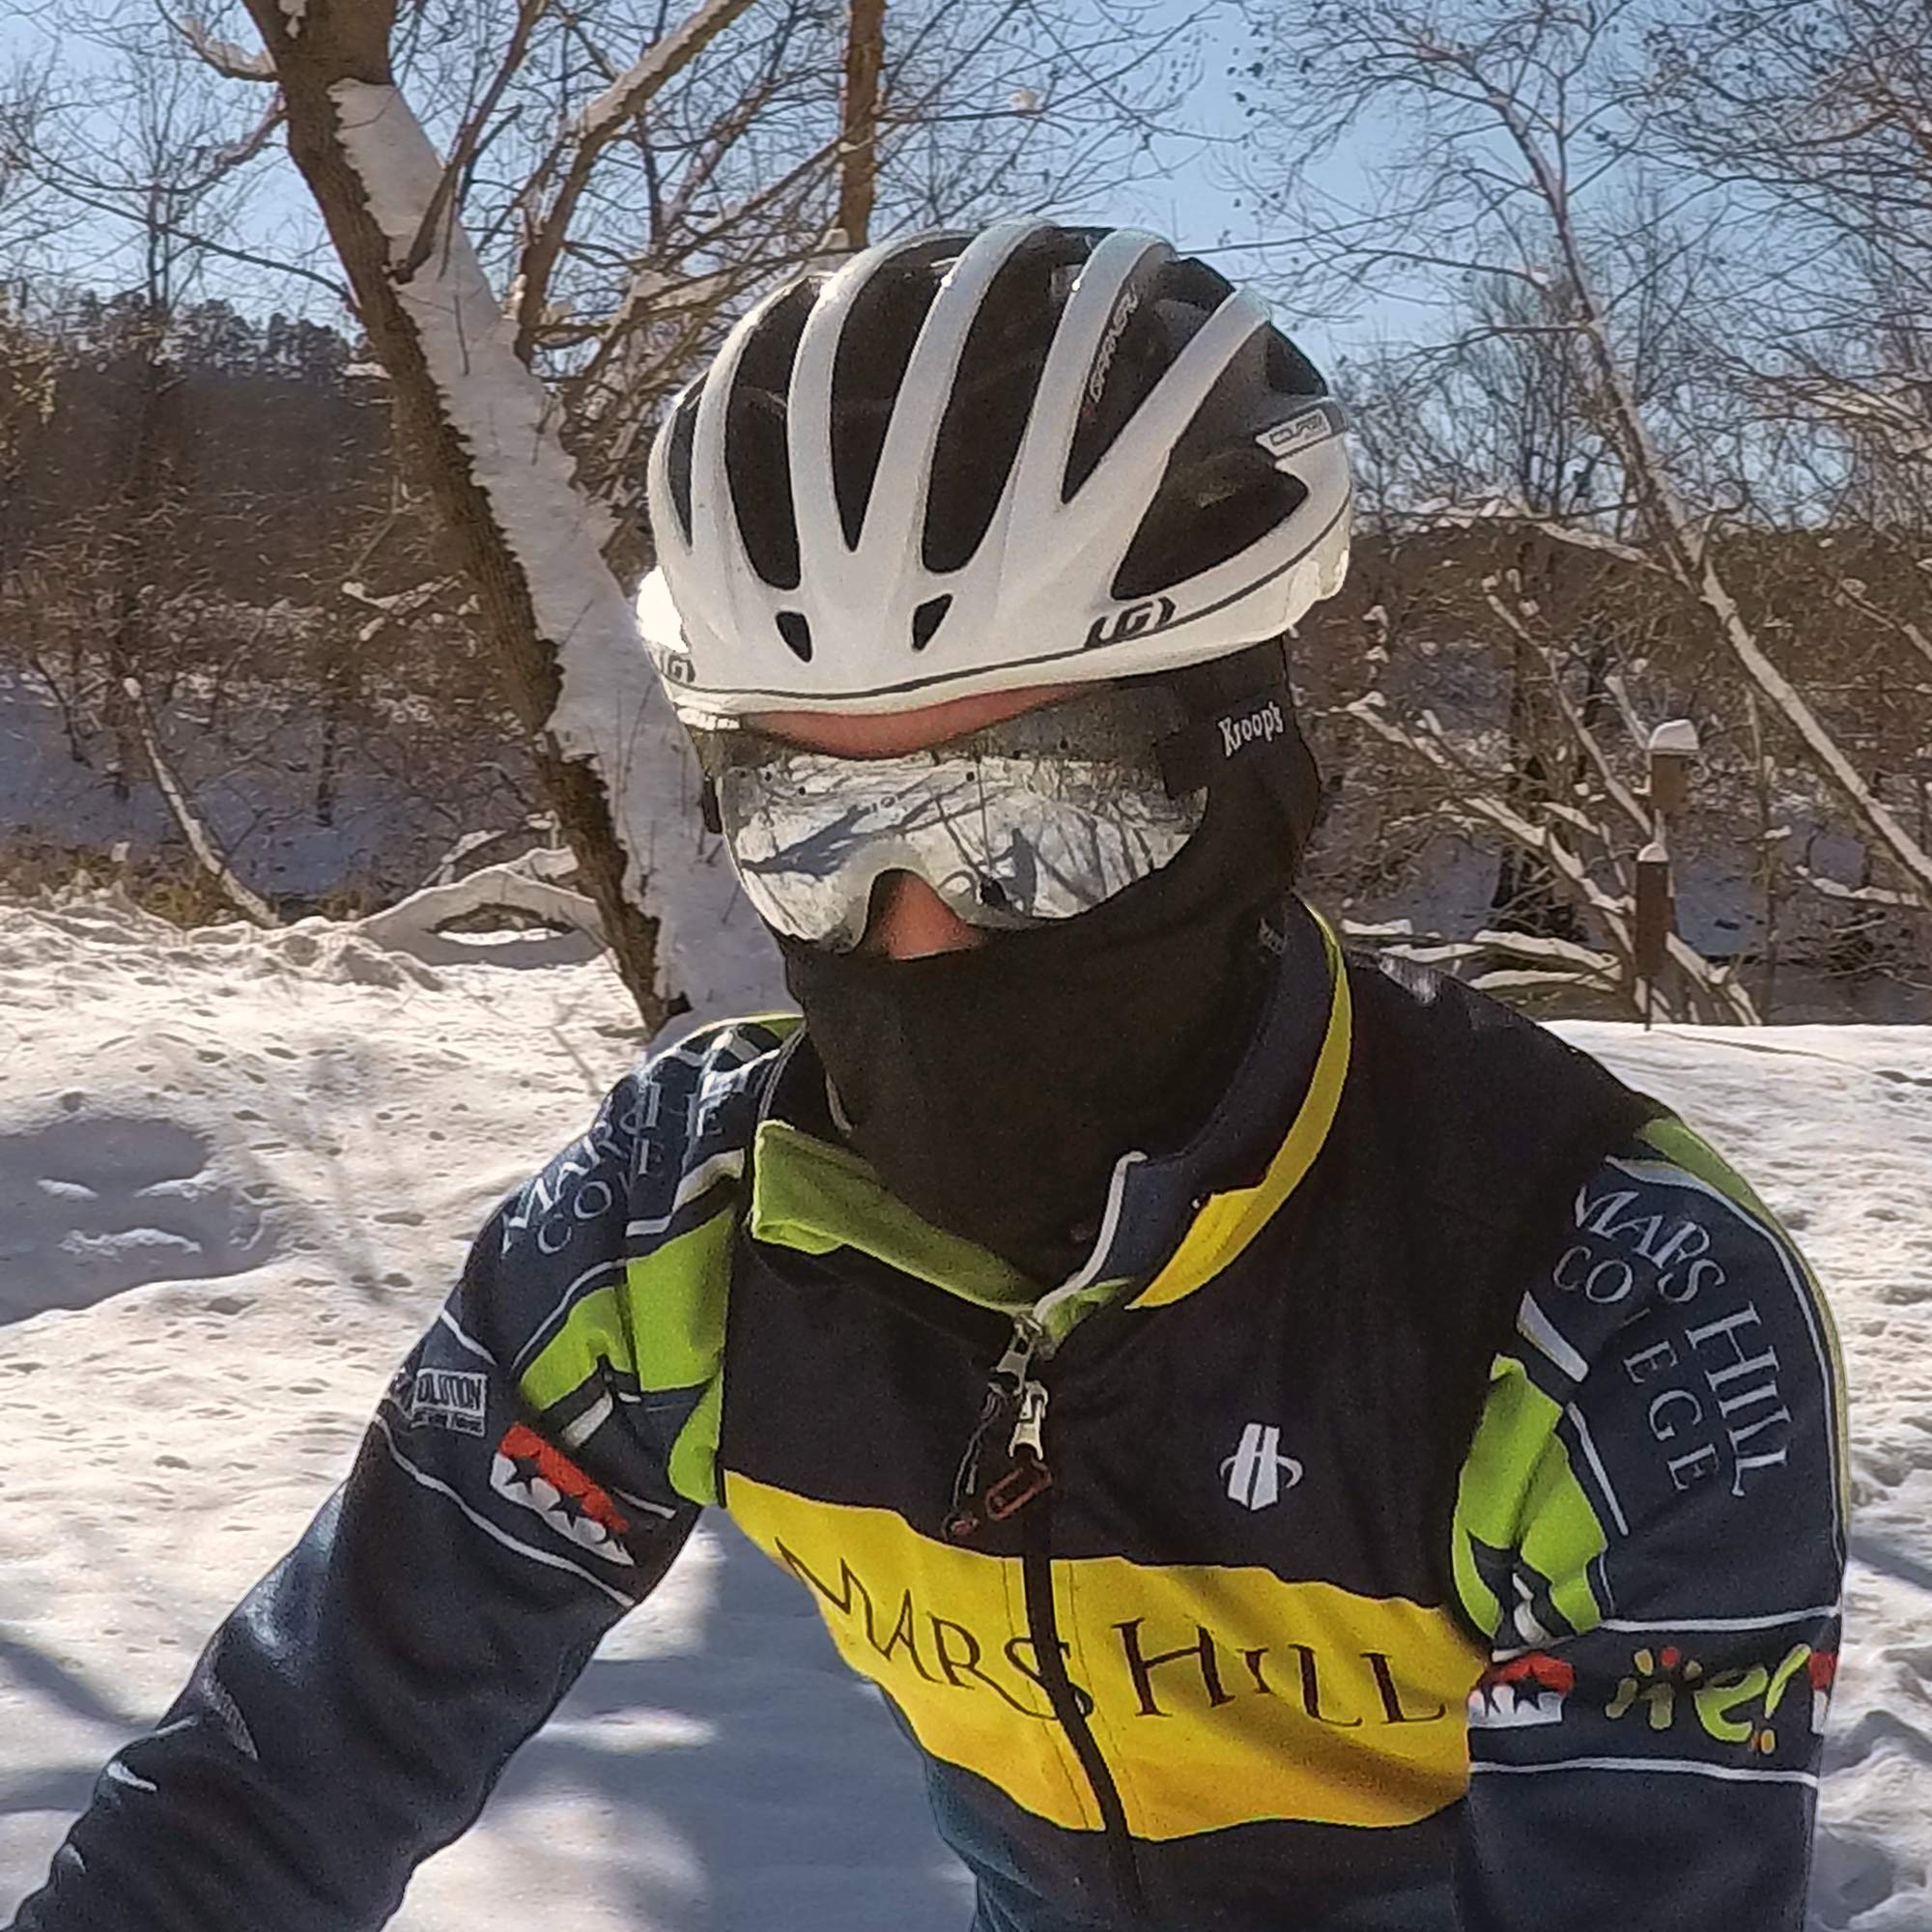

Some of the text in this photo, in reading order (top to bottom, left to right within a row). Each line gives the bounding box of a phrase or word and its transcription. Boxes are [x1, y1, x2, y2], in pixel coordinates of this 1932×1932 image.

[1574, 1185, 1725, 1303] MARS
[1685, 1301, 1792, 1497] HILL
[775, 1537, 1094, 1721] MARS
[1113, 1616, 1447, 1727] HILL
